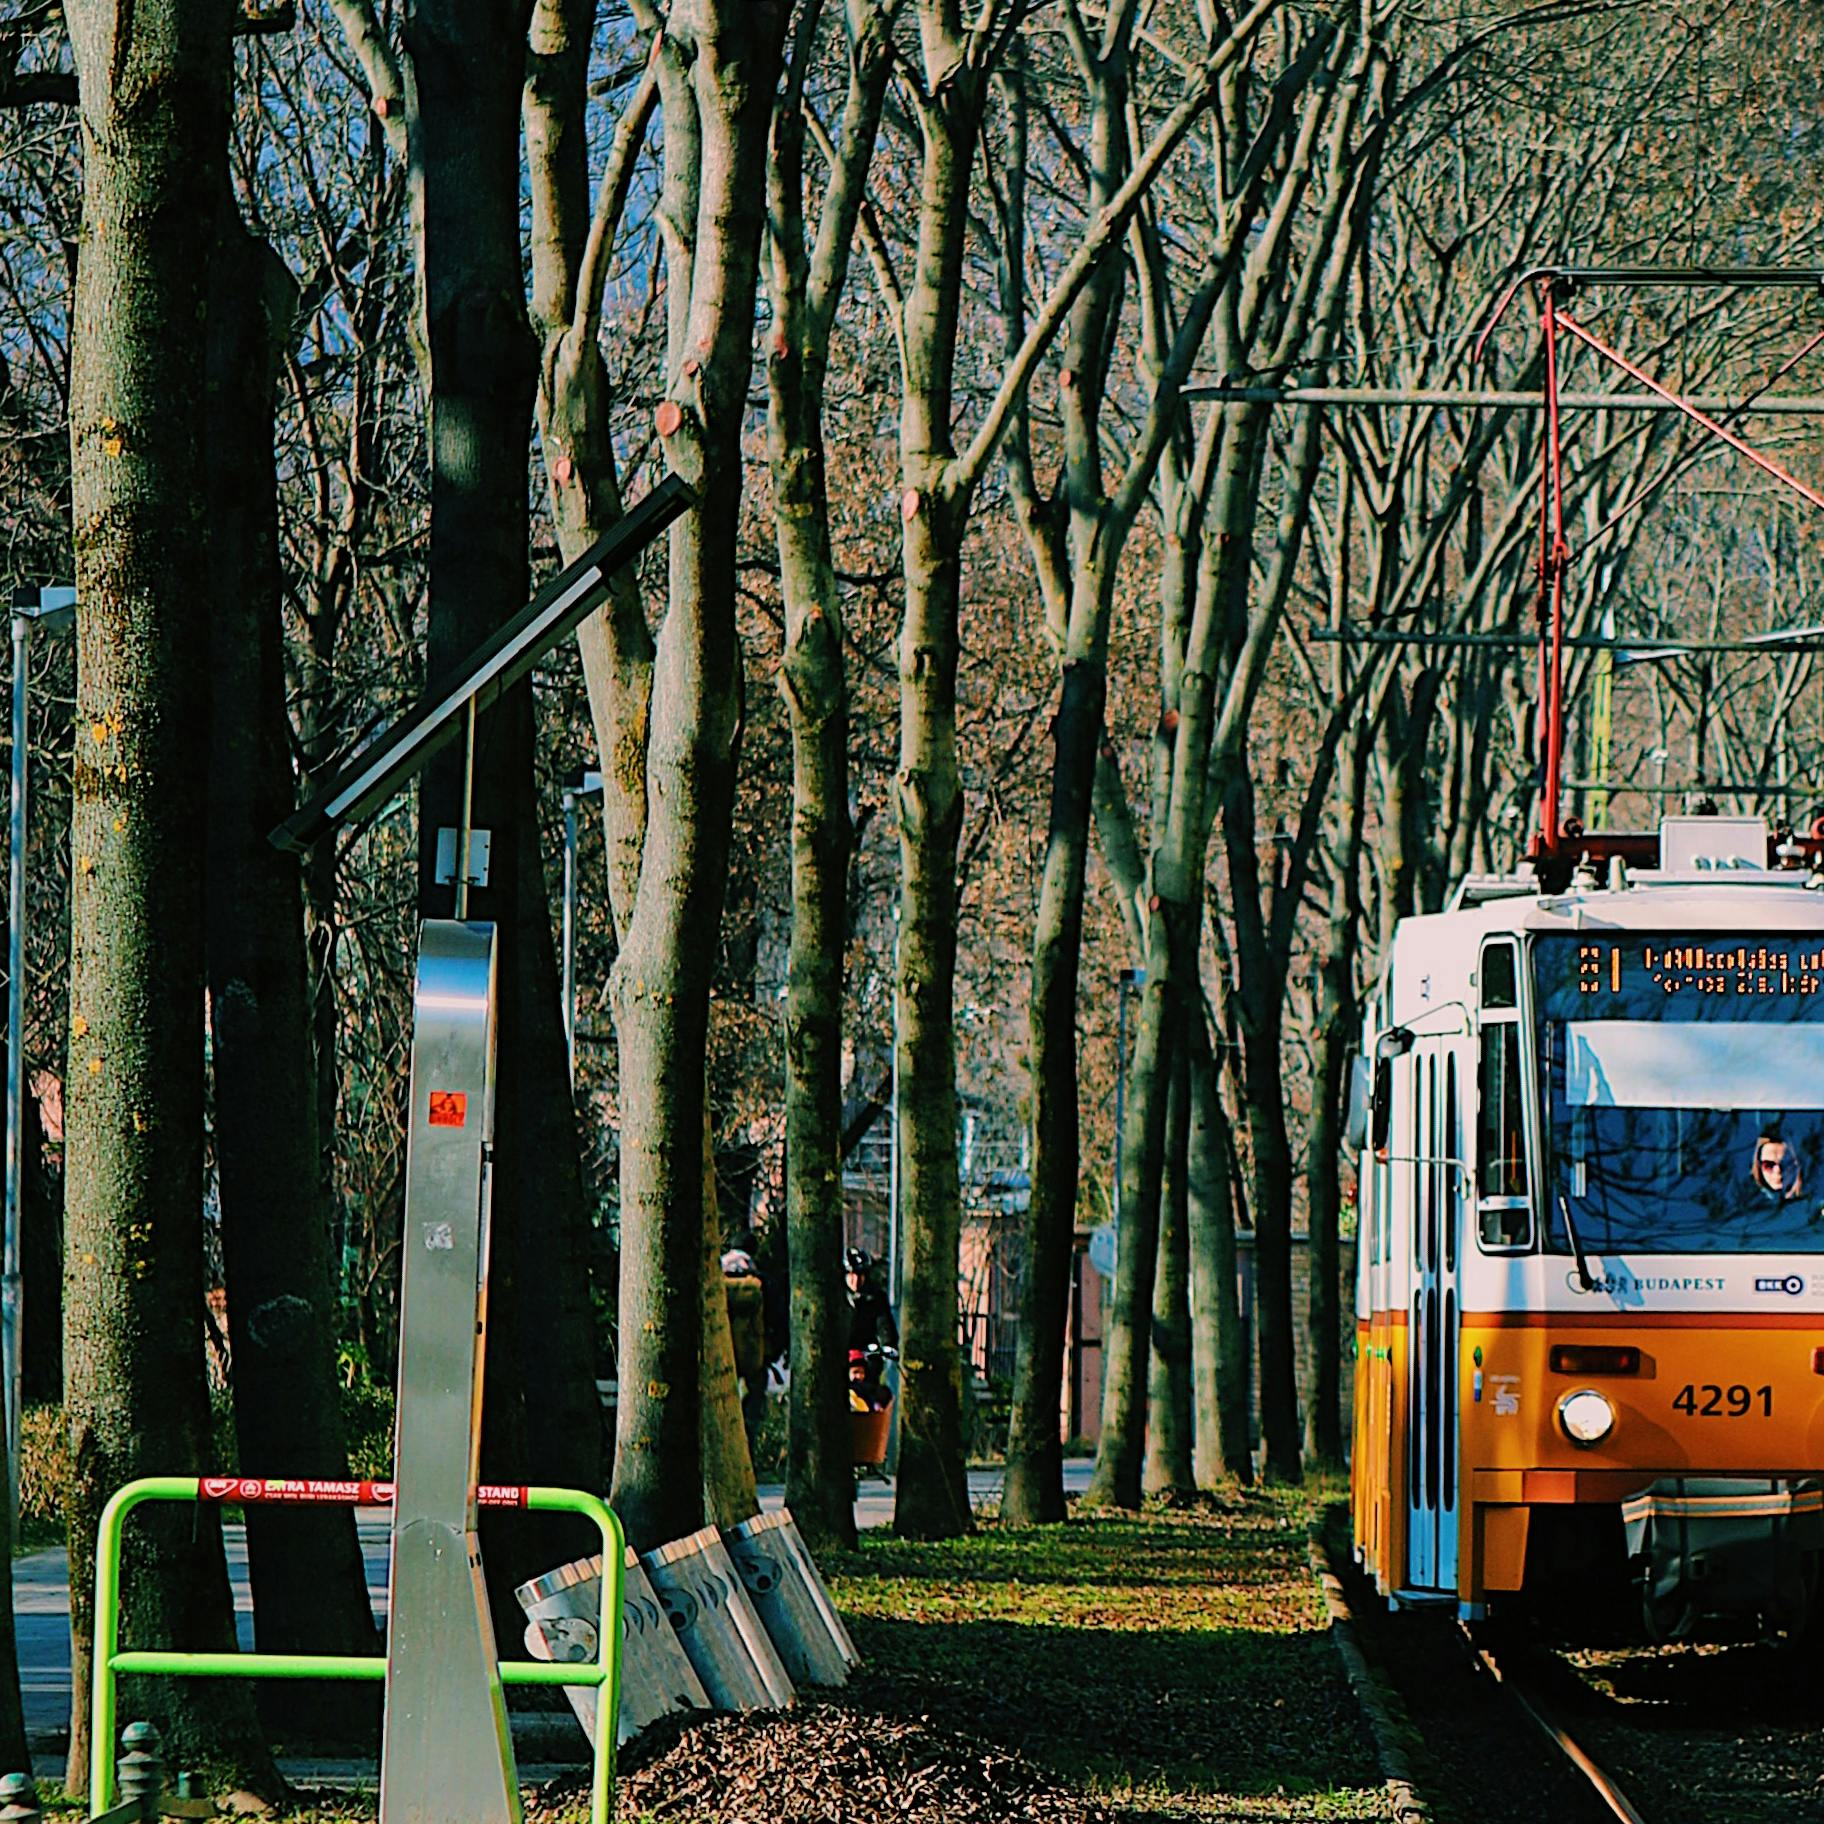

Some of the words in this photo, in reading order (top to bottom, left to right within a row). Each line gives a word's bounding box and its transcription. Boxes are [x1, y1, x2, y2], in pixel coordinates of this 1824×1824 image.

[1634, 1278, 1725, 1291] BUDAPEST
[1672, 1384, 1771, 1417] 4291
[478, 1486, 519, 1499] STAND
